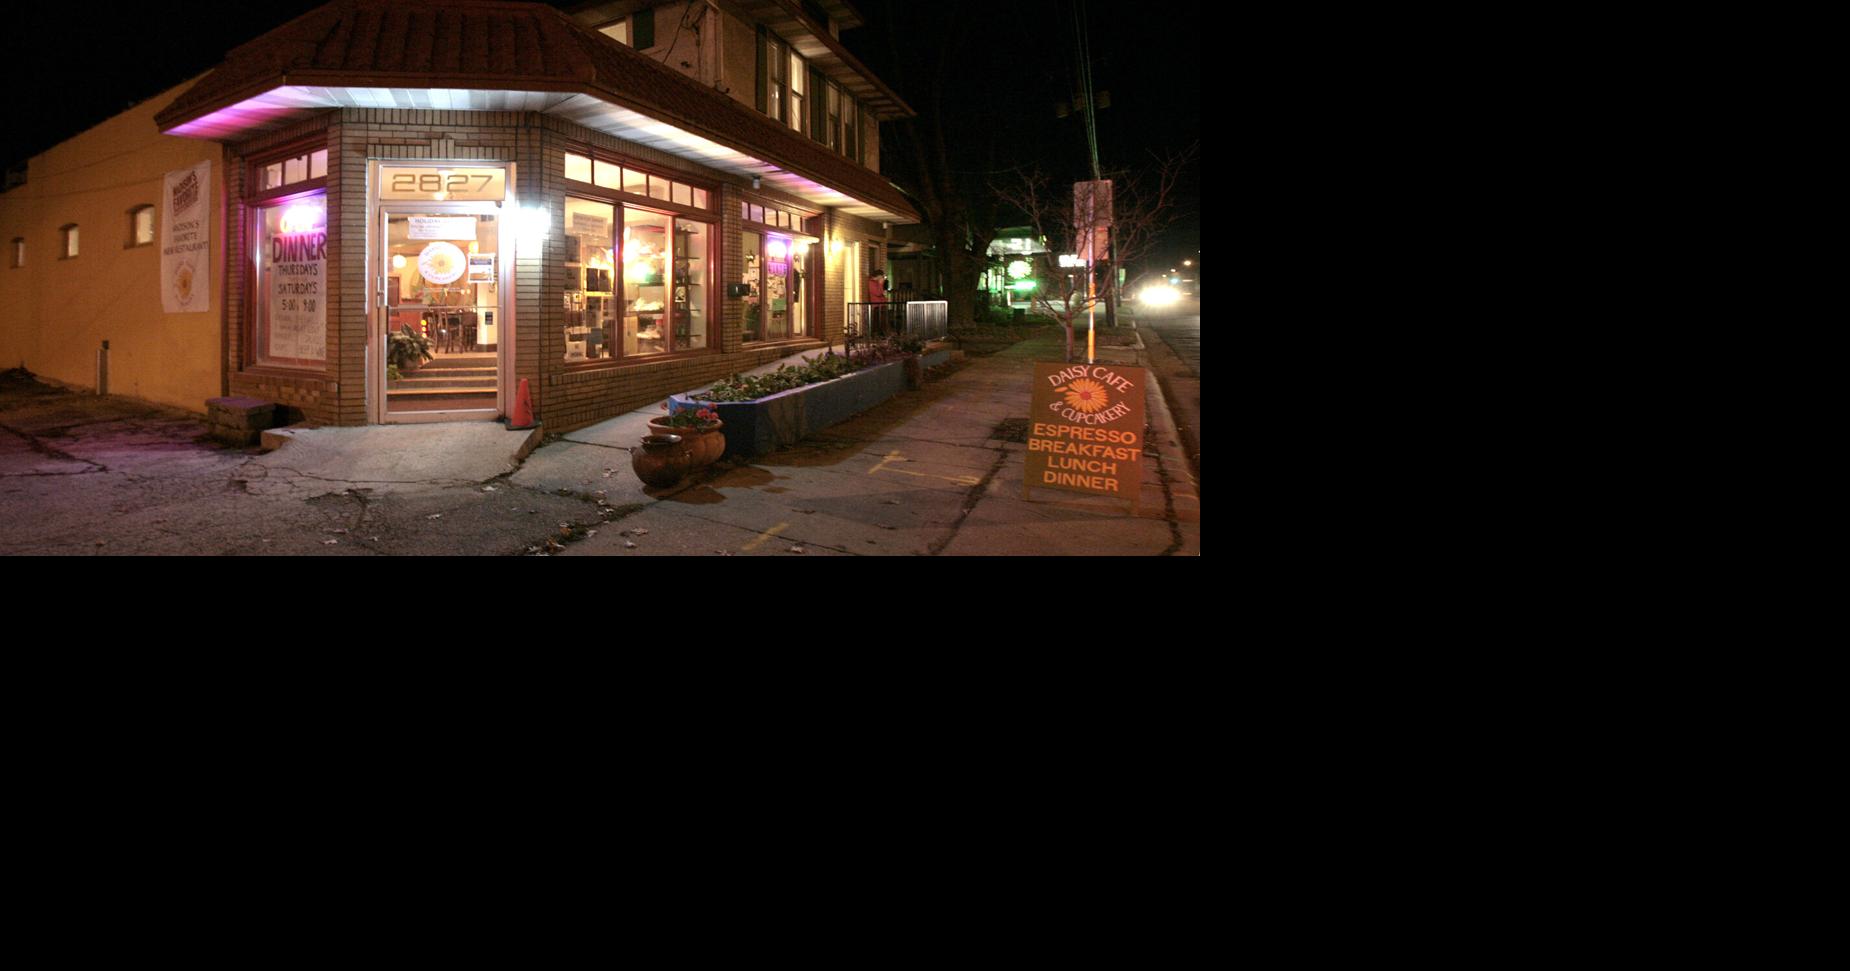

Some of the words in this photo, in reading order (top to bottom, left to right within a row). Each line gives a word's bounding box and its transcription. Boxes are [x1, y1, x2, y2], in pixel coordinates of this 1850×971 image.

[391, 173, 493, 192] 2827
[272, 232, 327, 263] DINNER
[278, 263, 318, 276] THURSDAYS
[278, 281, 318, 295] SATURDAYS
[1048, 365, 1091, 387] DAISY
[1092, 366, 1135, 393] CAFE
[1049, 401, 1063, 412] &
[1061, 401, 1131, 425] CUPCAKERY
[1033, 422, 1137, 445] ESPRESSO
[1028, 438, 1141, 461] BREAKFAST
[1047, 455, 1117, 475] LUNCH
[1043, 470, 1119, 492] DINNER
